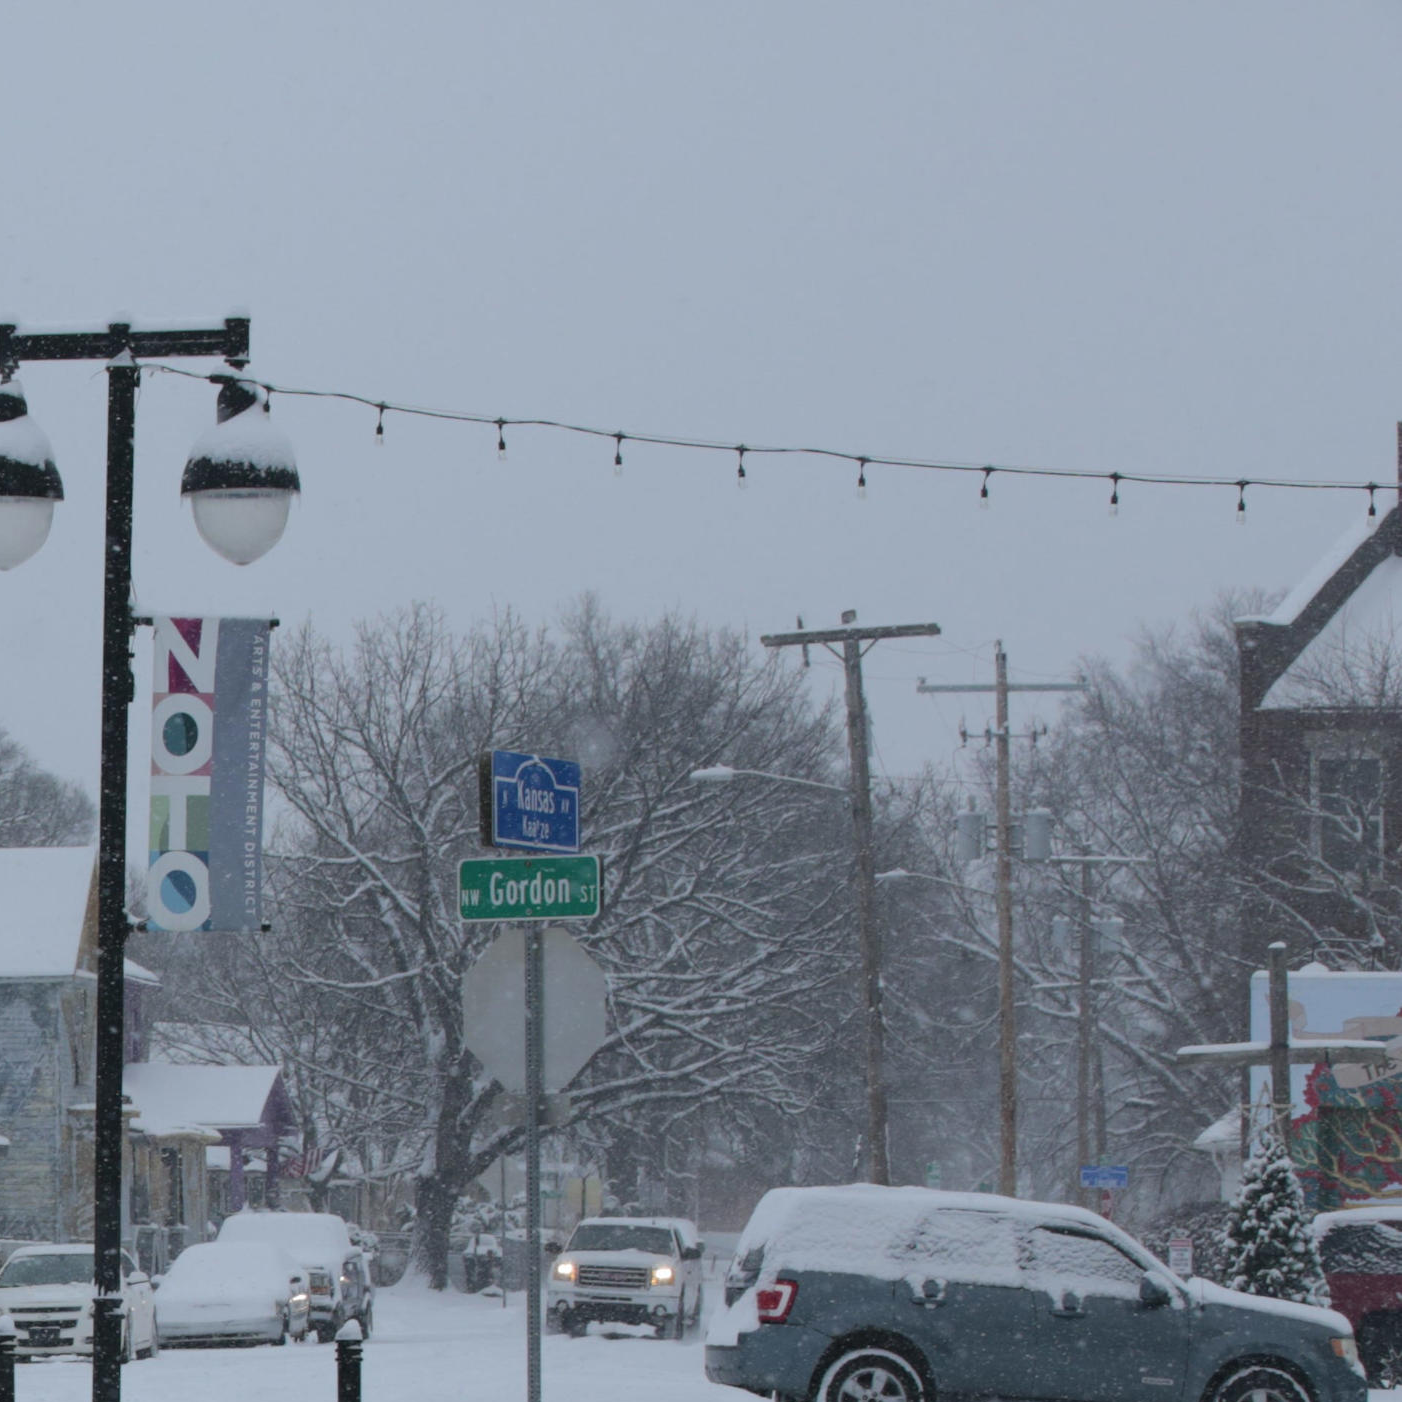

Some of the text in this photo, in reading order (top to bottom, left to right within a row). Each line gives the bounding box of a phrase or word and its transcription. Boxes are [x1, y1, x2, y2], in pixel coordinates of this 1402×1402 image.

[147, 617, 220, 932] NOTO
[243, 634, 265, 916] ARTS & ENTERTAINMENT DISTRICT
[517, 780, 556, 814] Kansas
[460, 871, 596, 907] NW Gordon ST
